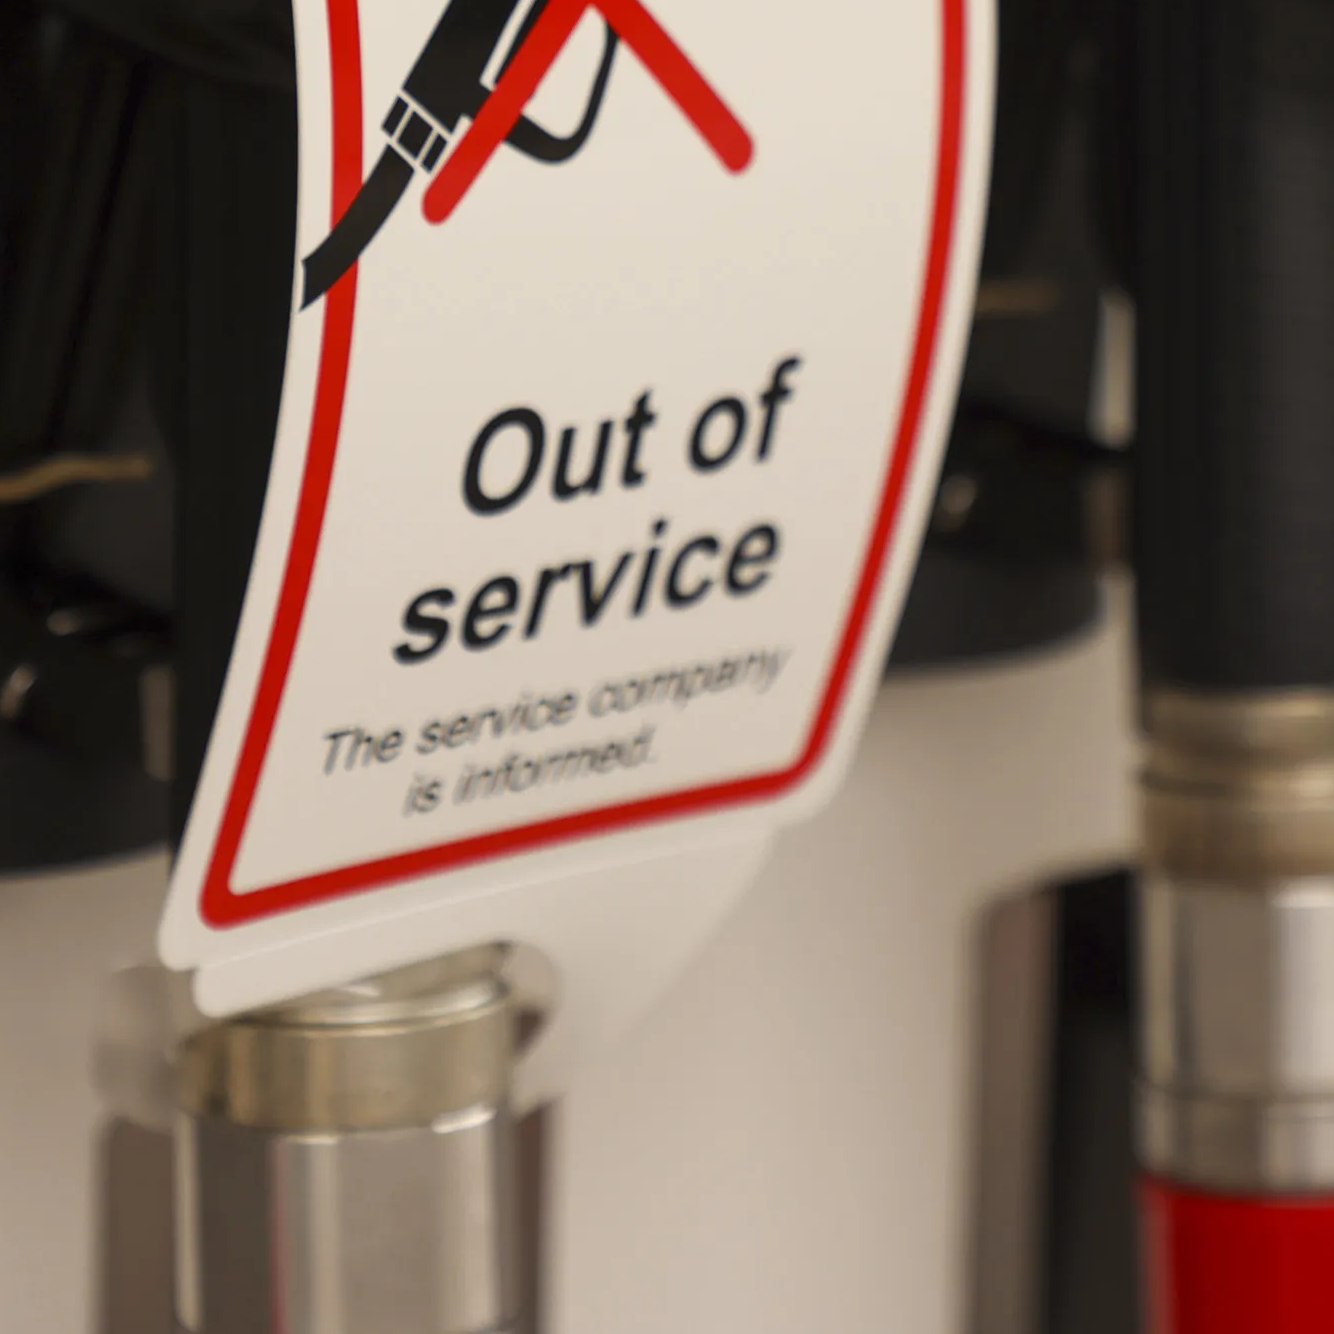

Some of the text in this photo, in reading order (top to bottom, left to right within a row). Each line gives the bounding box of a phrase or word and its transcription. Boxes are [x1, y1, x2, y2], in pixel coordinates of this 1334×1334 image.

[462, 356, 801, 516] Out of
[393, 519, 779, 665] service
[325, 650, 789, 773] The service company
[407, 731, 657, 817] is informed.
